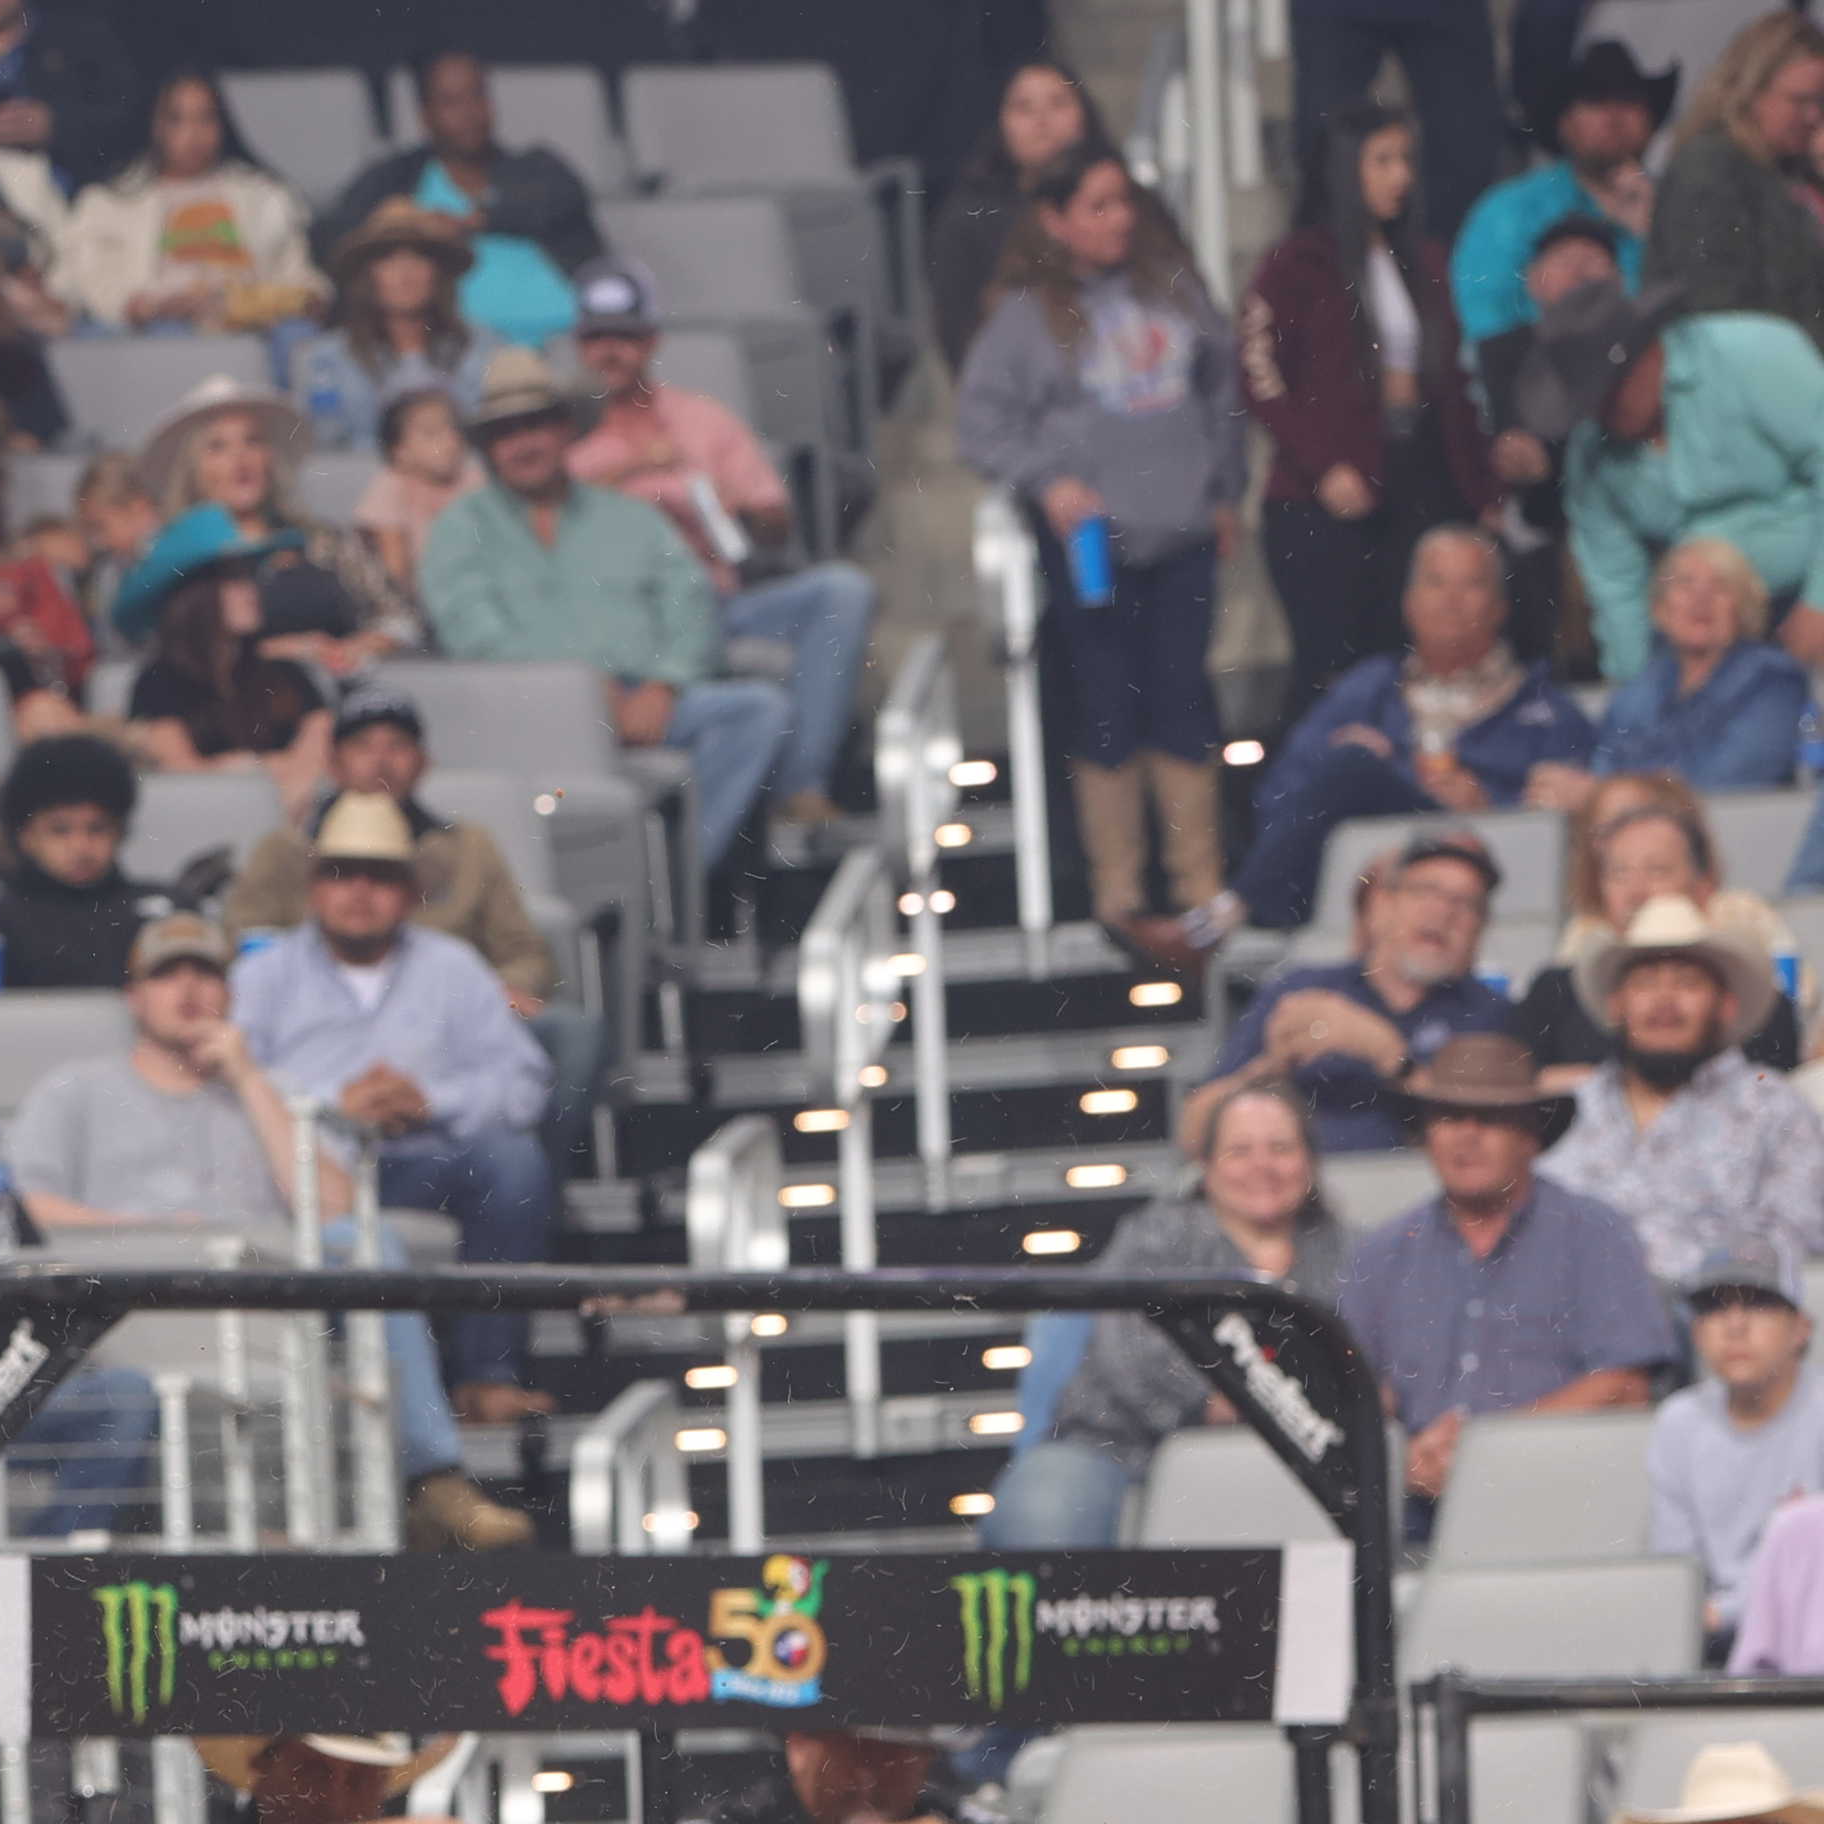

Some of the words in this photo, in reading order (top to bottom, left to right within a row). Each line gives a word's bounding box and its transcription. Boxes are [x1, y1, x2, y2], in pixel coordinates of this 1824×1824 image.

[178, 1606, 366, 1649] MONSTER
[1036, 1592, 1221, 1637] MONSTER
[480, 1596, 712, 1717] Fiesta
[706, 1588, 829, 1684] 50
